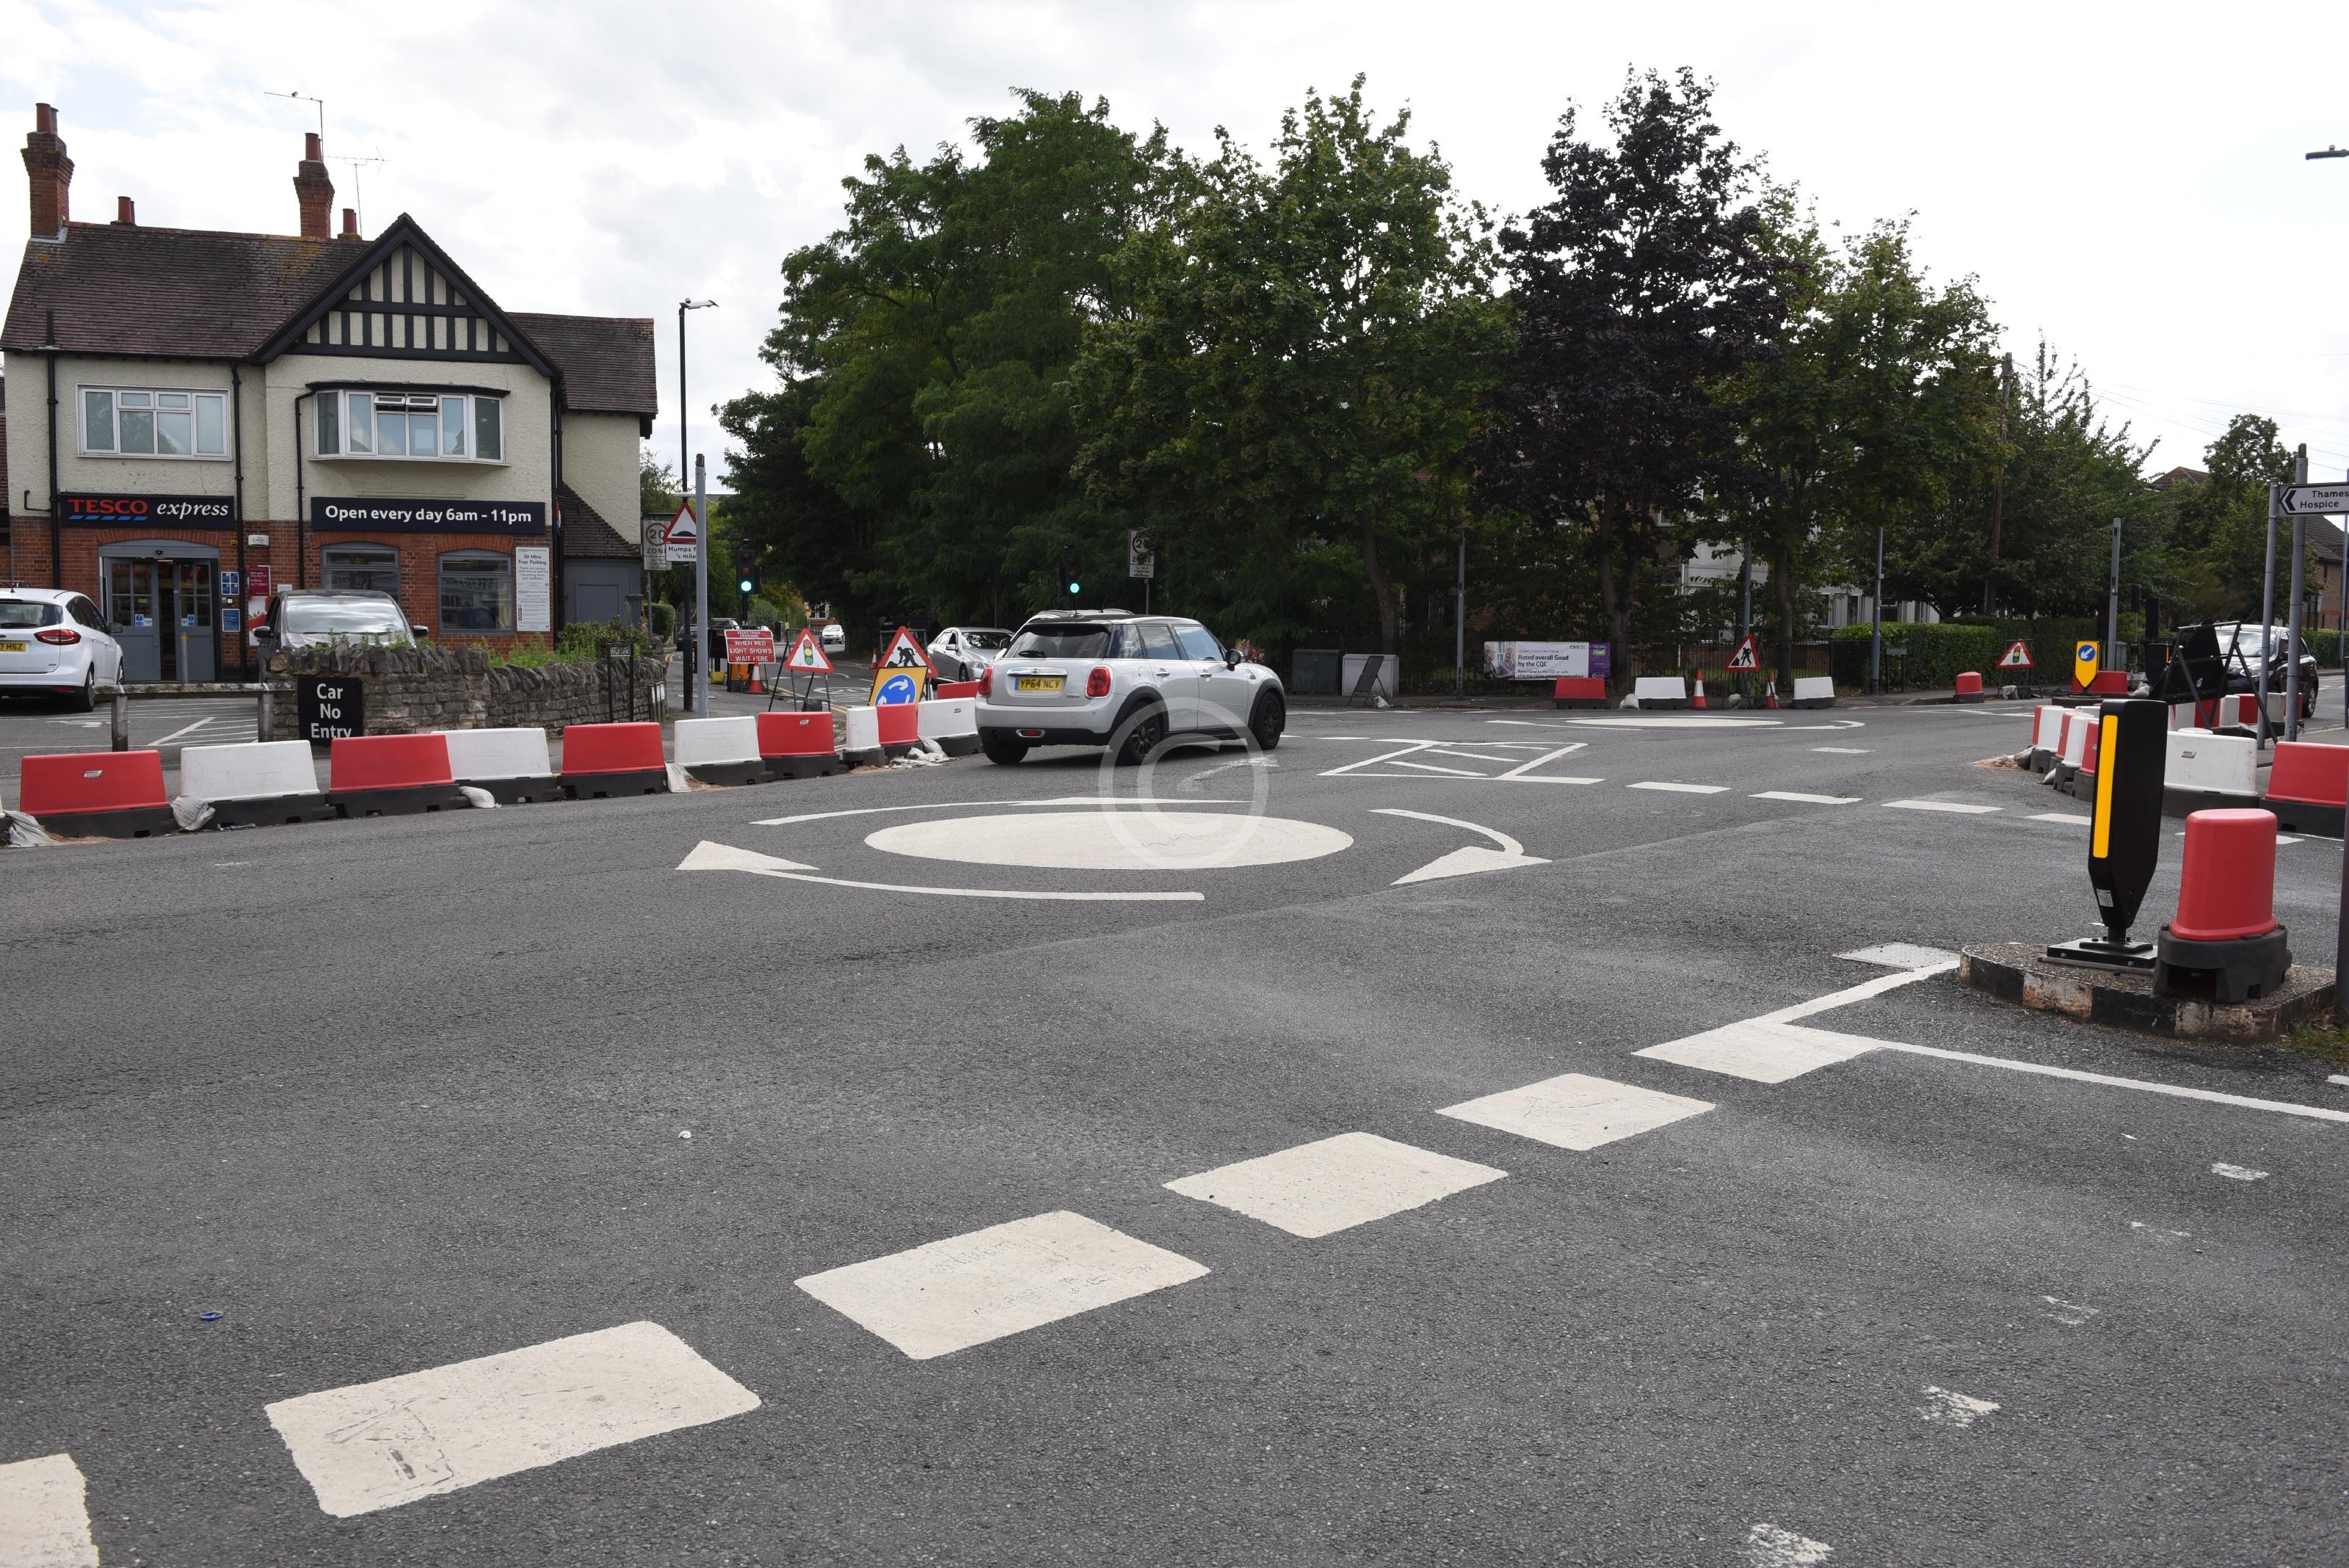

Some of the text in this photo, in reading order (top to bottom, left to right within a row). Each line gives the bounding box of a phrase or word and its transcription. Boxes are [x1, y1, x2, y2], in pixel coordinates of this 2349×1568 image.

[68, 498, 229, 520] TESCO express
[2300, 500, 2339, 509] Hospice
[325, 505, 367, 521] Open
[370, 508, 412, 523] every
[415, 508, 443, 523] day
[446, 508, 477, 521] 6am
[491, 509, 531, 524] 11pm
[316, 683, 344, 699] Car
[1020, 679, 1061, 688] YP64 NCV
[319, 703, 341, 719] No
[311, 722, 352, 738] Entry
